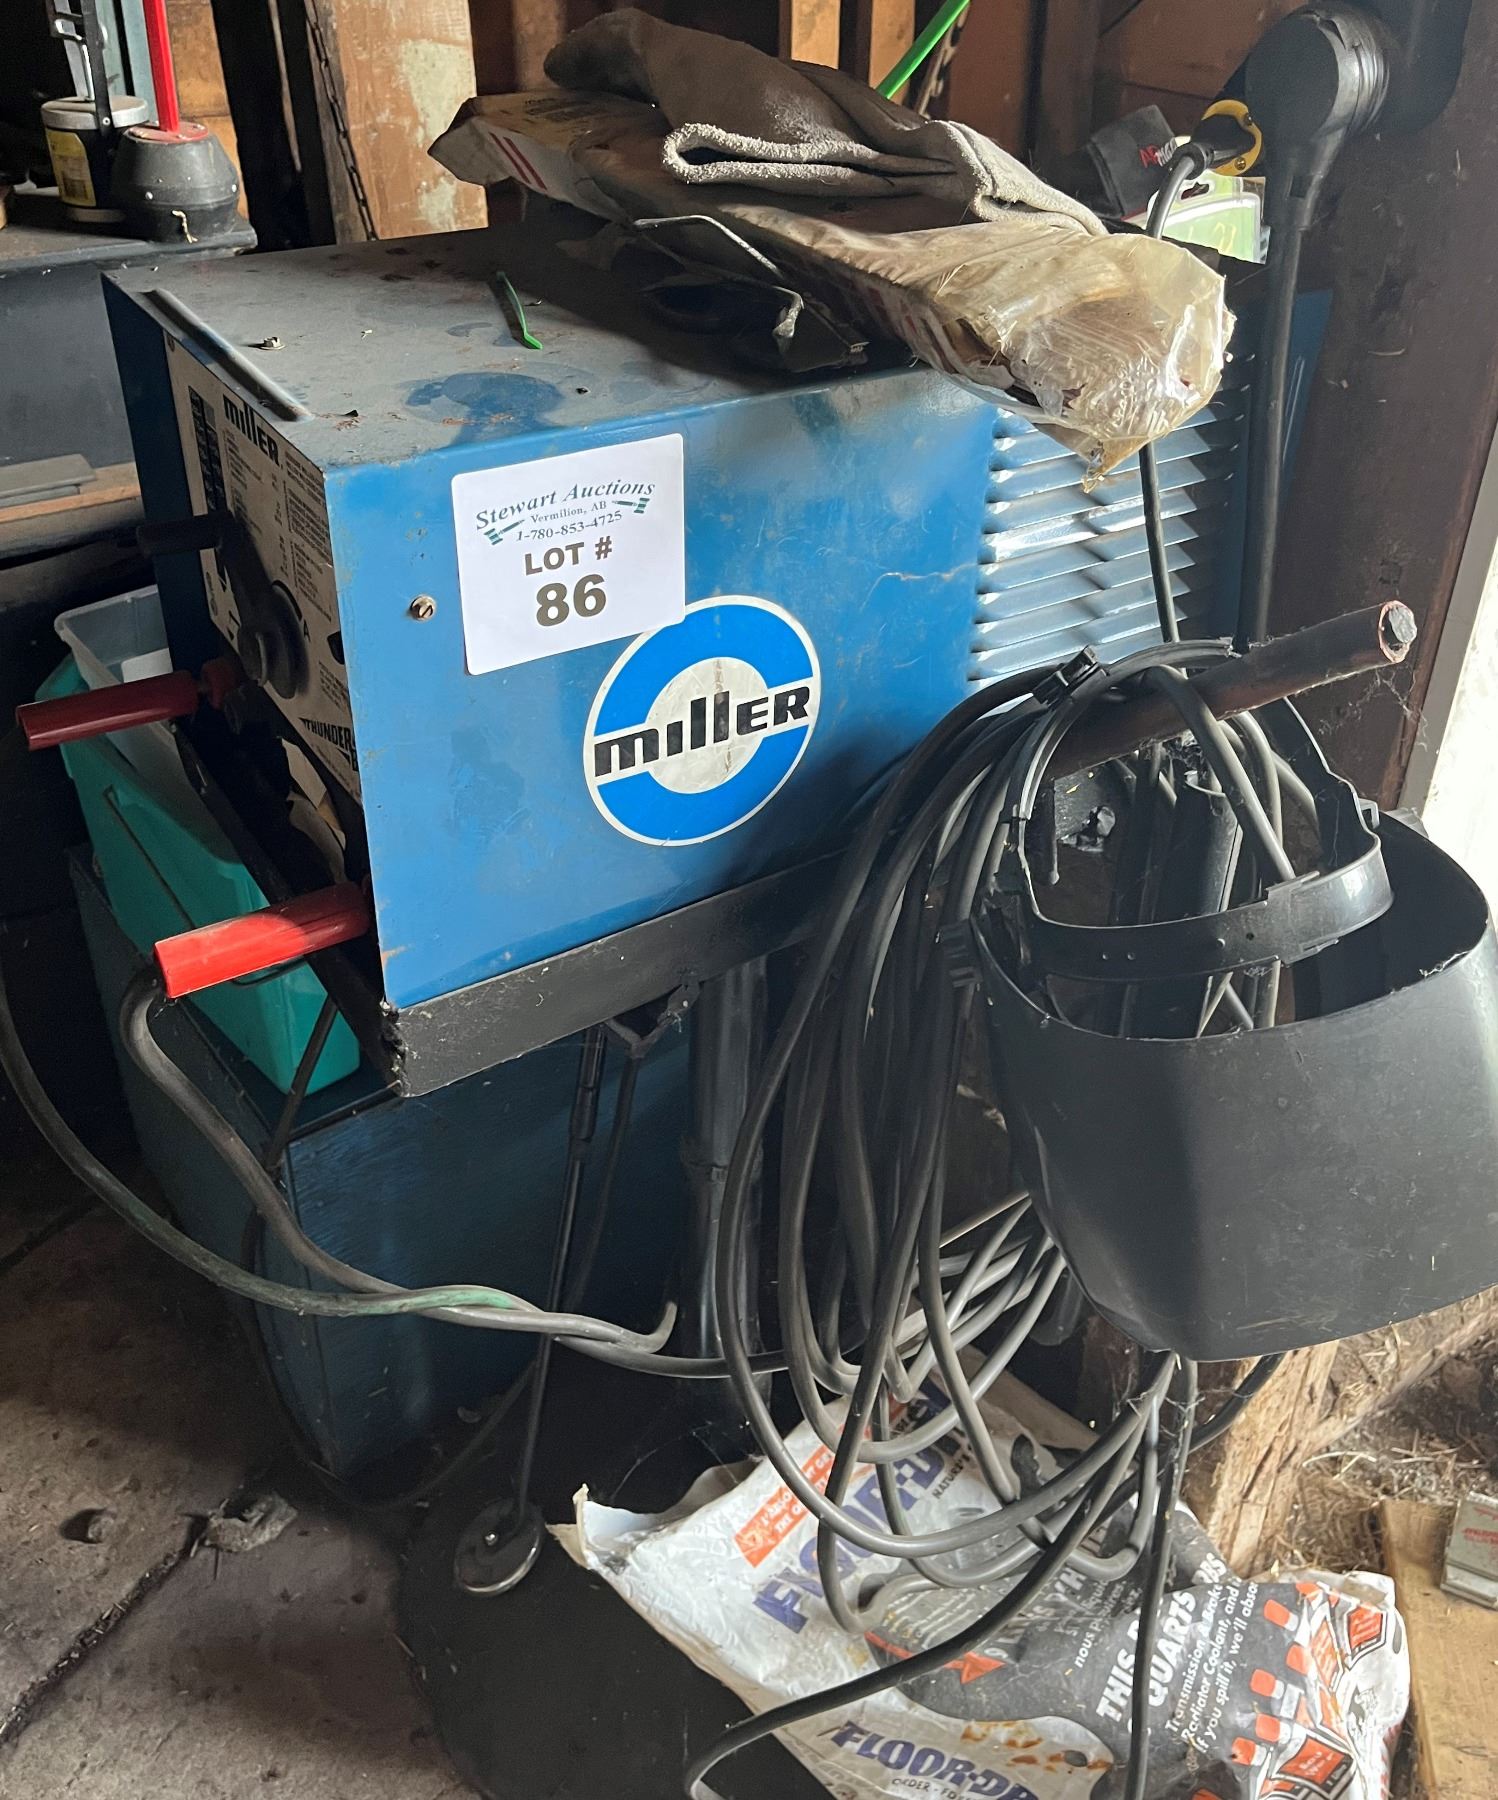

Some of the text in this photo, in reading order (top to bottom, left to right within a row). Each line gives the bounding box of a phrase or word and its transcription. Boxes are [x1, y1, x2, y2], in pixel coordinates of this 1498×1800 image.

[475, 479, 656, 530] Stewart Auctions
[515, 510, 622, 542] 1-780-853-4725
[530, 500, 607, 524] Vermilion, AB
[524, 535, 613, 576] LOT #
[536, 574, 607, 627] 86
[1074, 1631, 1097, 1668] nous
[1148, 1591, 1196, 1707] QUARTS
[1181, 1585, 1240, 1744] Radiator Coolant, and
[1096, 1649, 1135, 1722] THIS
[1165, 1638, 1206, 1732] Transmission
[1204, 1710, 1223, 1741] you
[1215, 1674, 1231, 1706] spill
[1229, 1617, 1248, 1655] we'll
